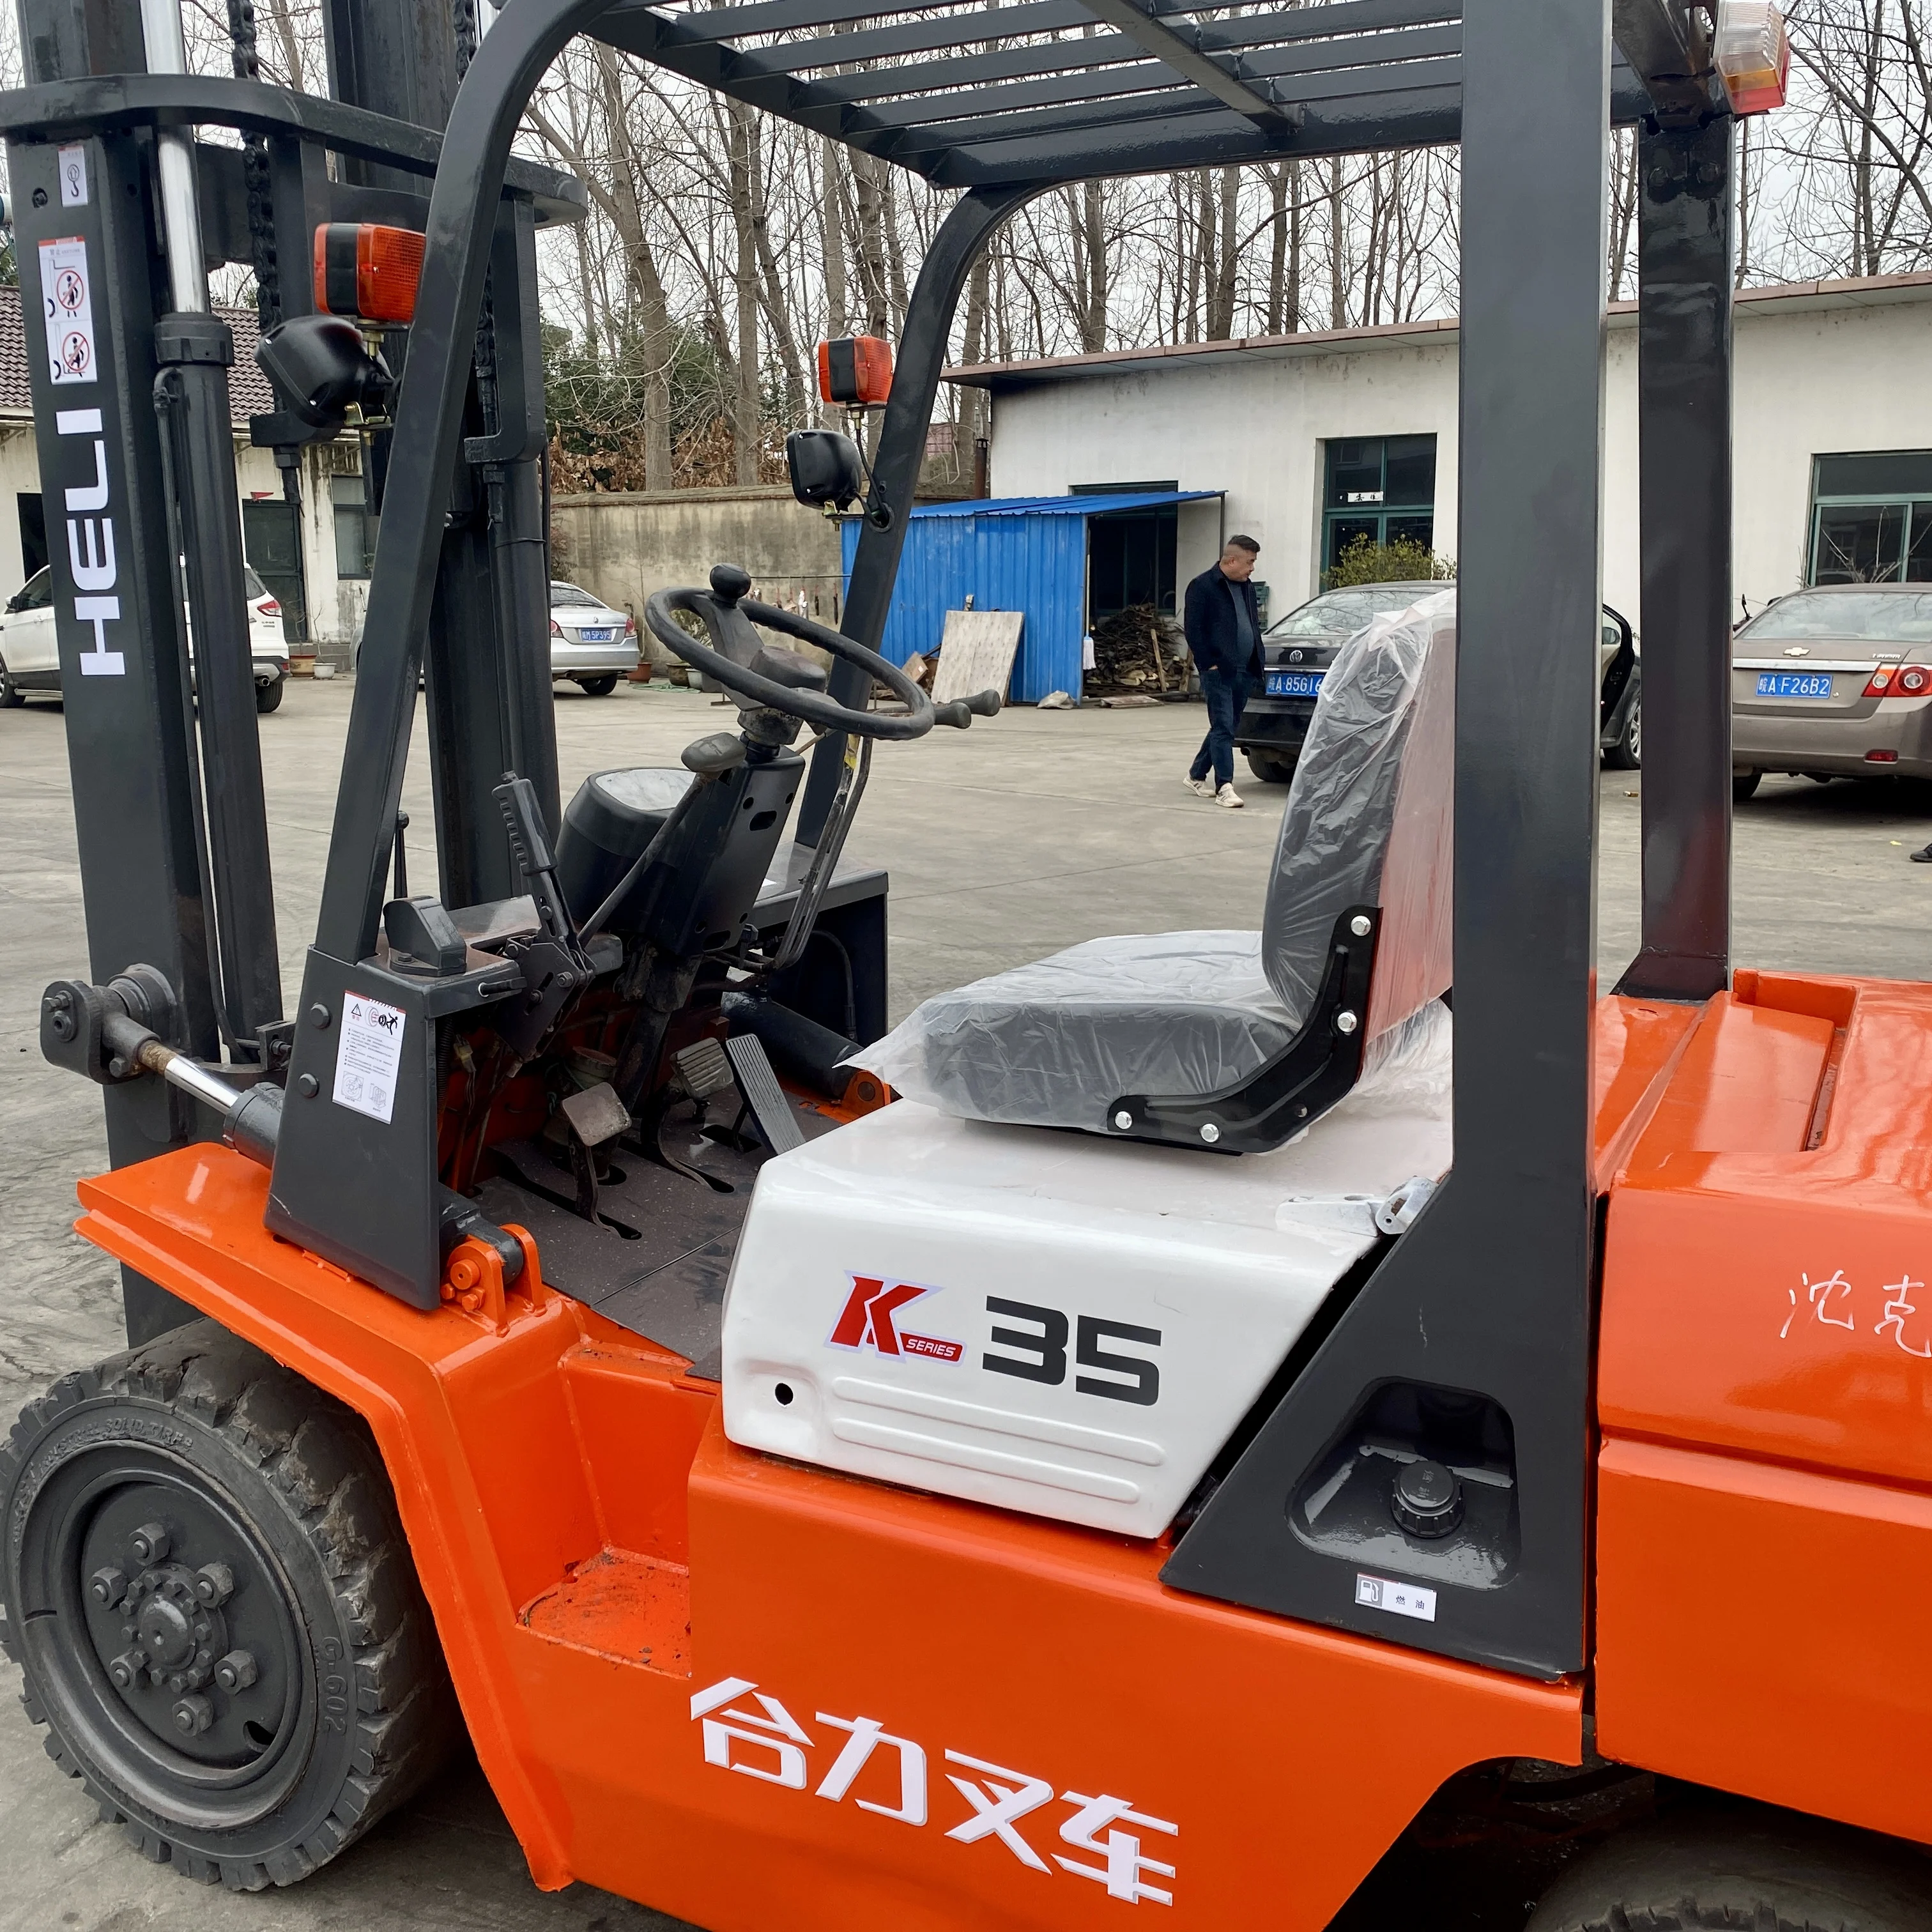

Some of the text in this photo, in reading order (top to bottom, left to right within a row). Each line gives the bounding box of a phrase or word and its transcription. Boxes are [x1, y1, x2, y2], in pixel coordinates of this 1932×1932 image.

[56, 408, 125, 676] HELI
[830, 1275, 957, 1358] K SERIES
[982, 1295, 1162, 1407] 35
[320, 1636, 349, 1736] G-602
[690, 1676, 1179, 1907] 合力叉车
